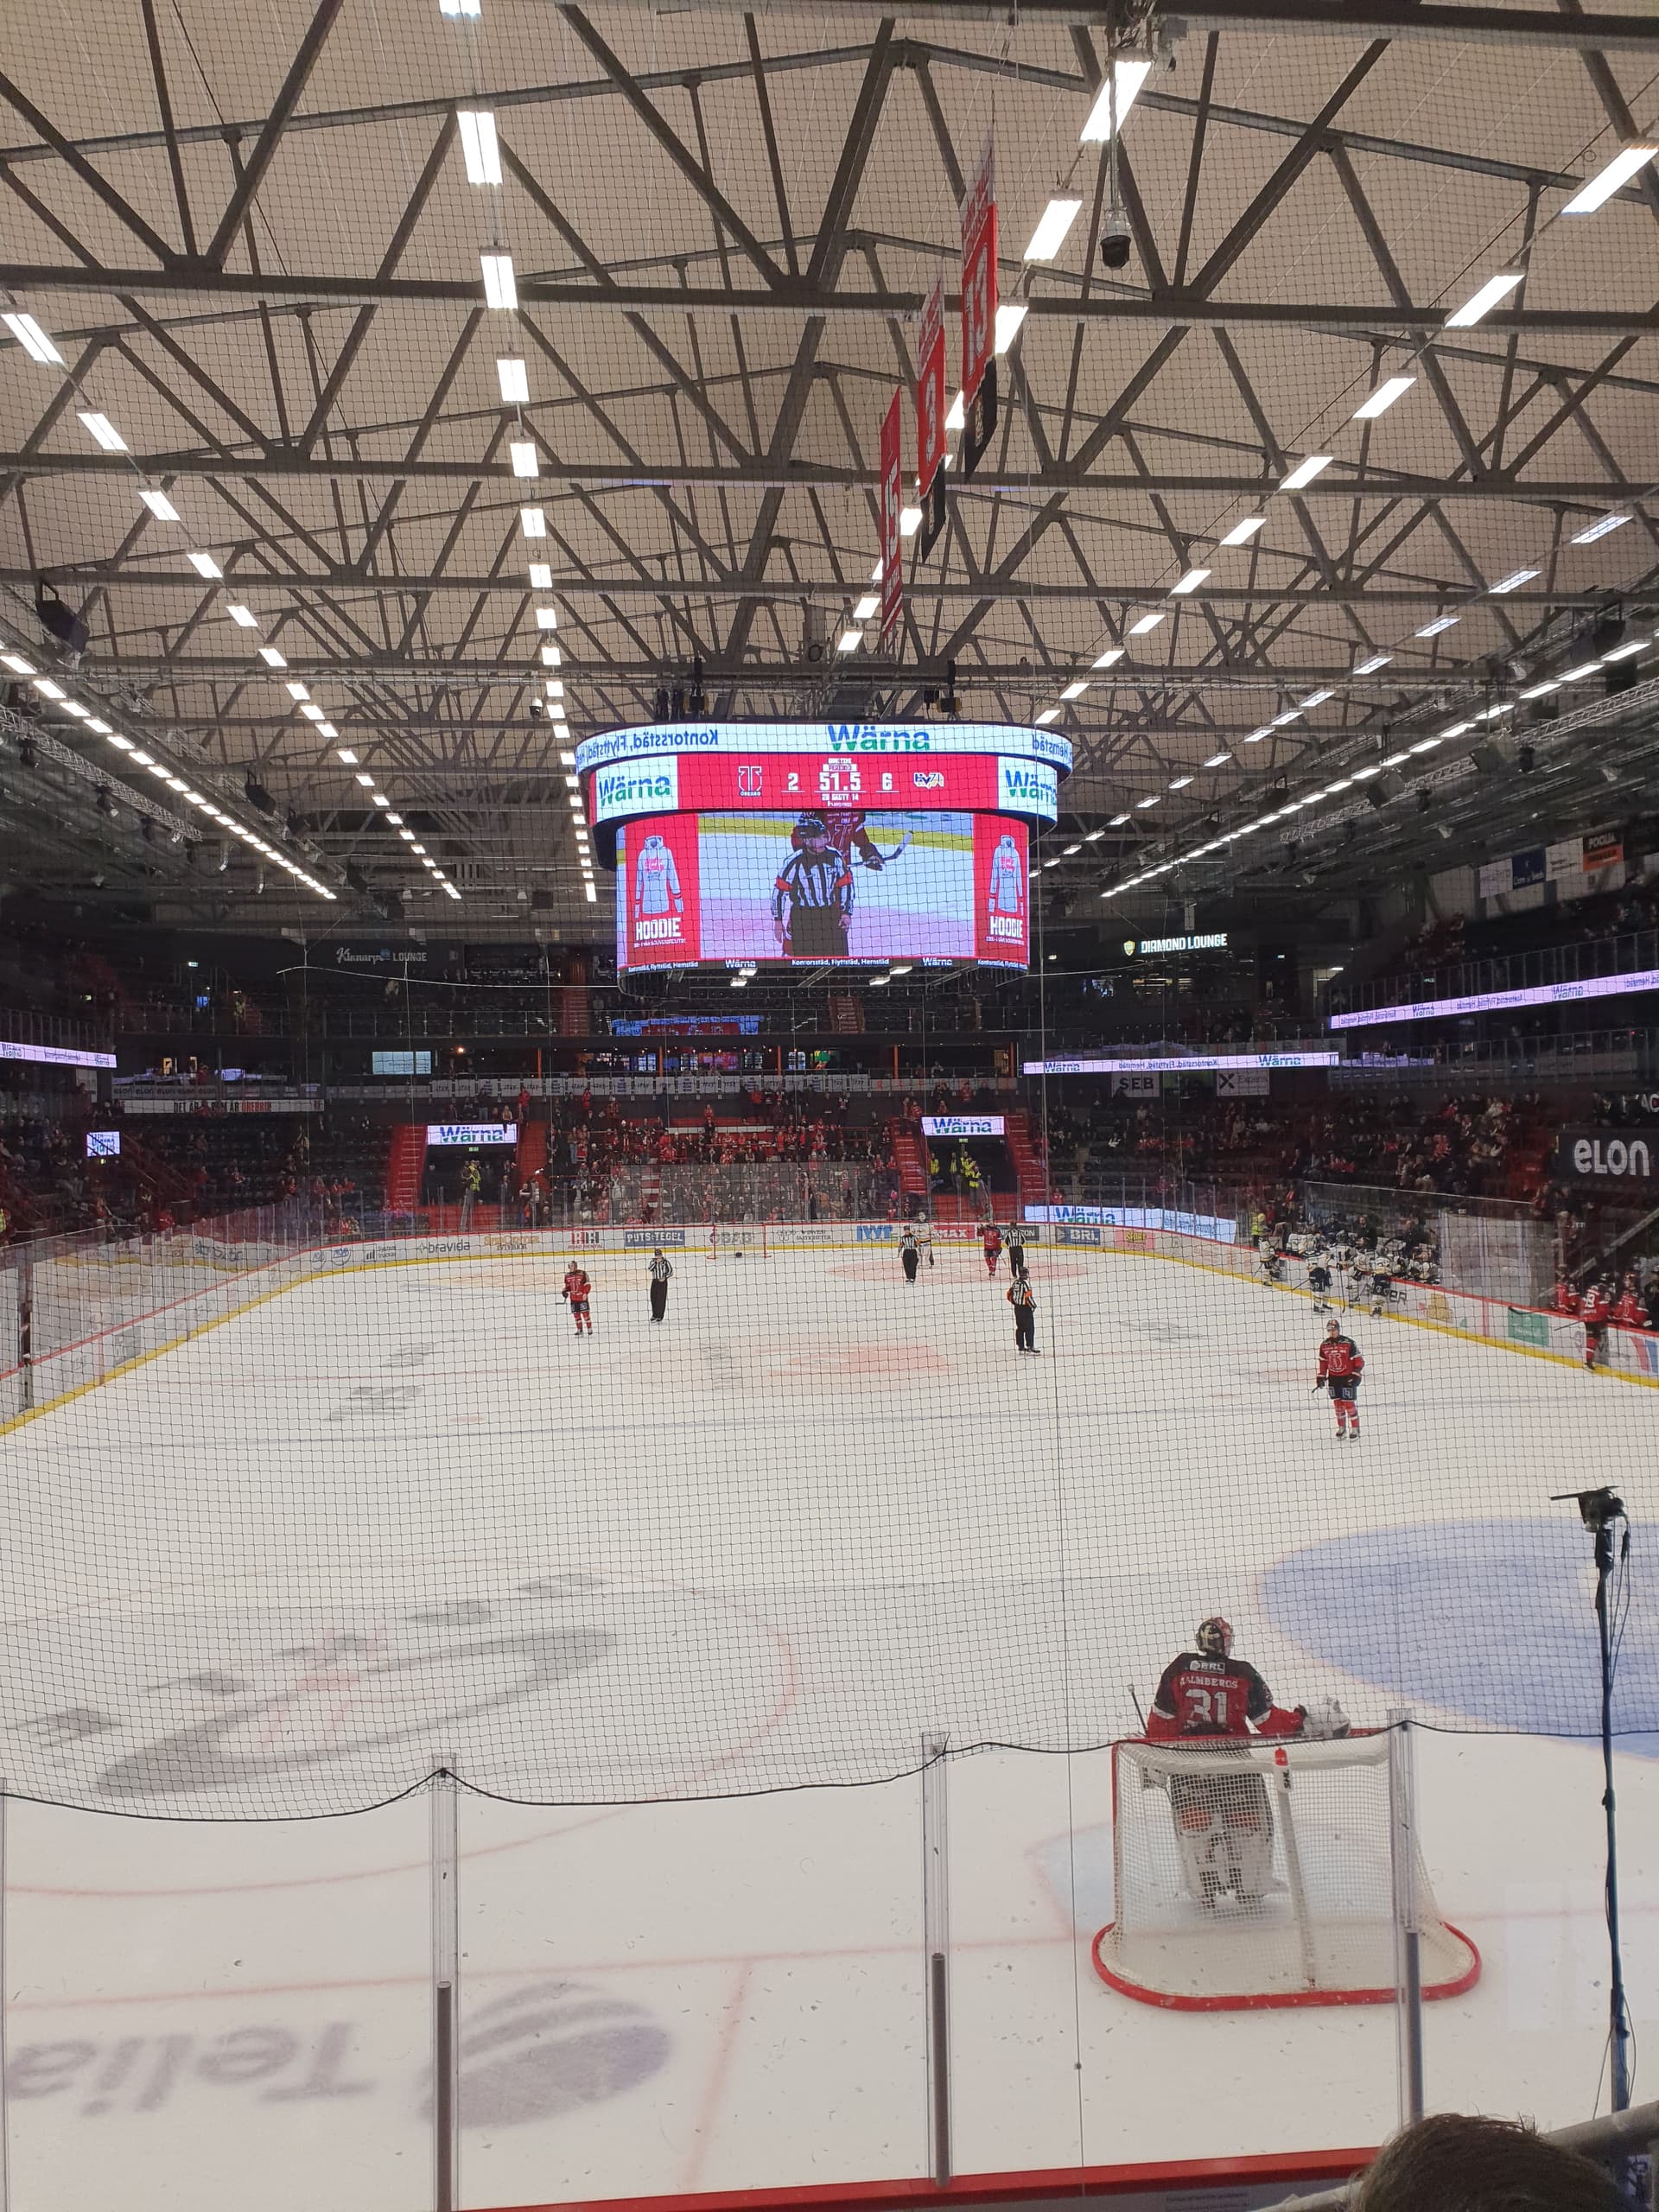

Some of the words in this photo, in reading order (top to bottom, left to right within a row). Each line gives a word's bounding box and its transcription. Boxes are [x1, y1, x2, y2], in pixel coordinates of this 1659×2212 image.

[964, 242, 988, 380] 13
[828, 724, 930, 751] Wärna
[599, 775, 671, 807] Wärna
[787, 772, 798, 791] 2
[819, 772, 861, 791] 51.5
[881, 772, 893, 791] 6
[635, 917, 682, 941] HOODIE
[989, 915, 1023, 938] HOODIE
[1141, 937, 1186, 954] DIAMOND
[1187, 932, 1228, 950] LOUNGE
[392, 952, 428, 962] LOUNGE
[1258, 1053, 1301, 1066] Wärna
[1119, 1077, 1154, 1090] SEB
[440, 1126, 504, 1142] Wärna
[933, 1117, 992, 1134] Wärna
[1055, 1206, 1116, 1224] Wärna
[428, 1239, 471, 1254] bravida
[626, 1232, 651, 1243] PUTS
[655, 1231, 683, 1242] TEGEL
[1185, 1688, 1228, 1724] 31
[3, 2022, 378, 2118] Telia
